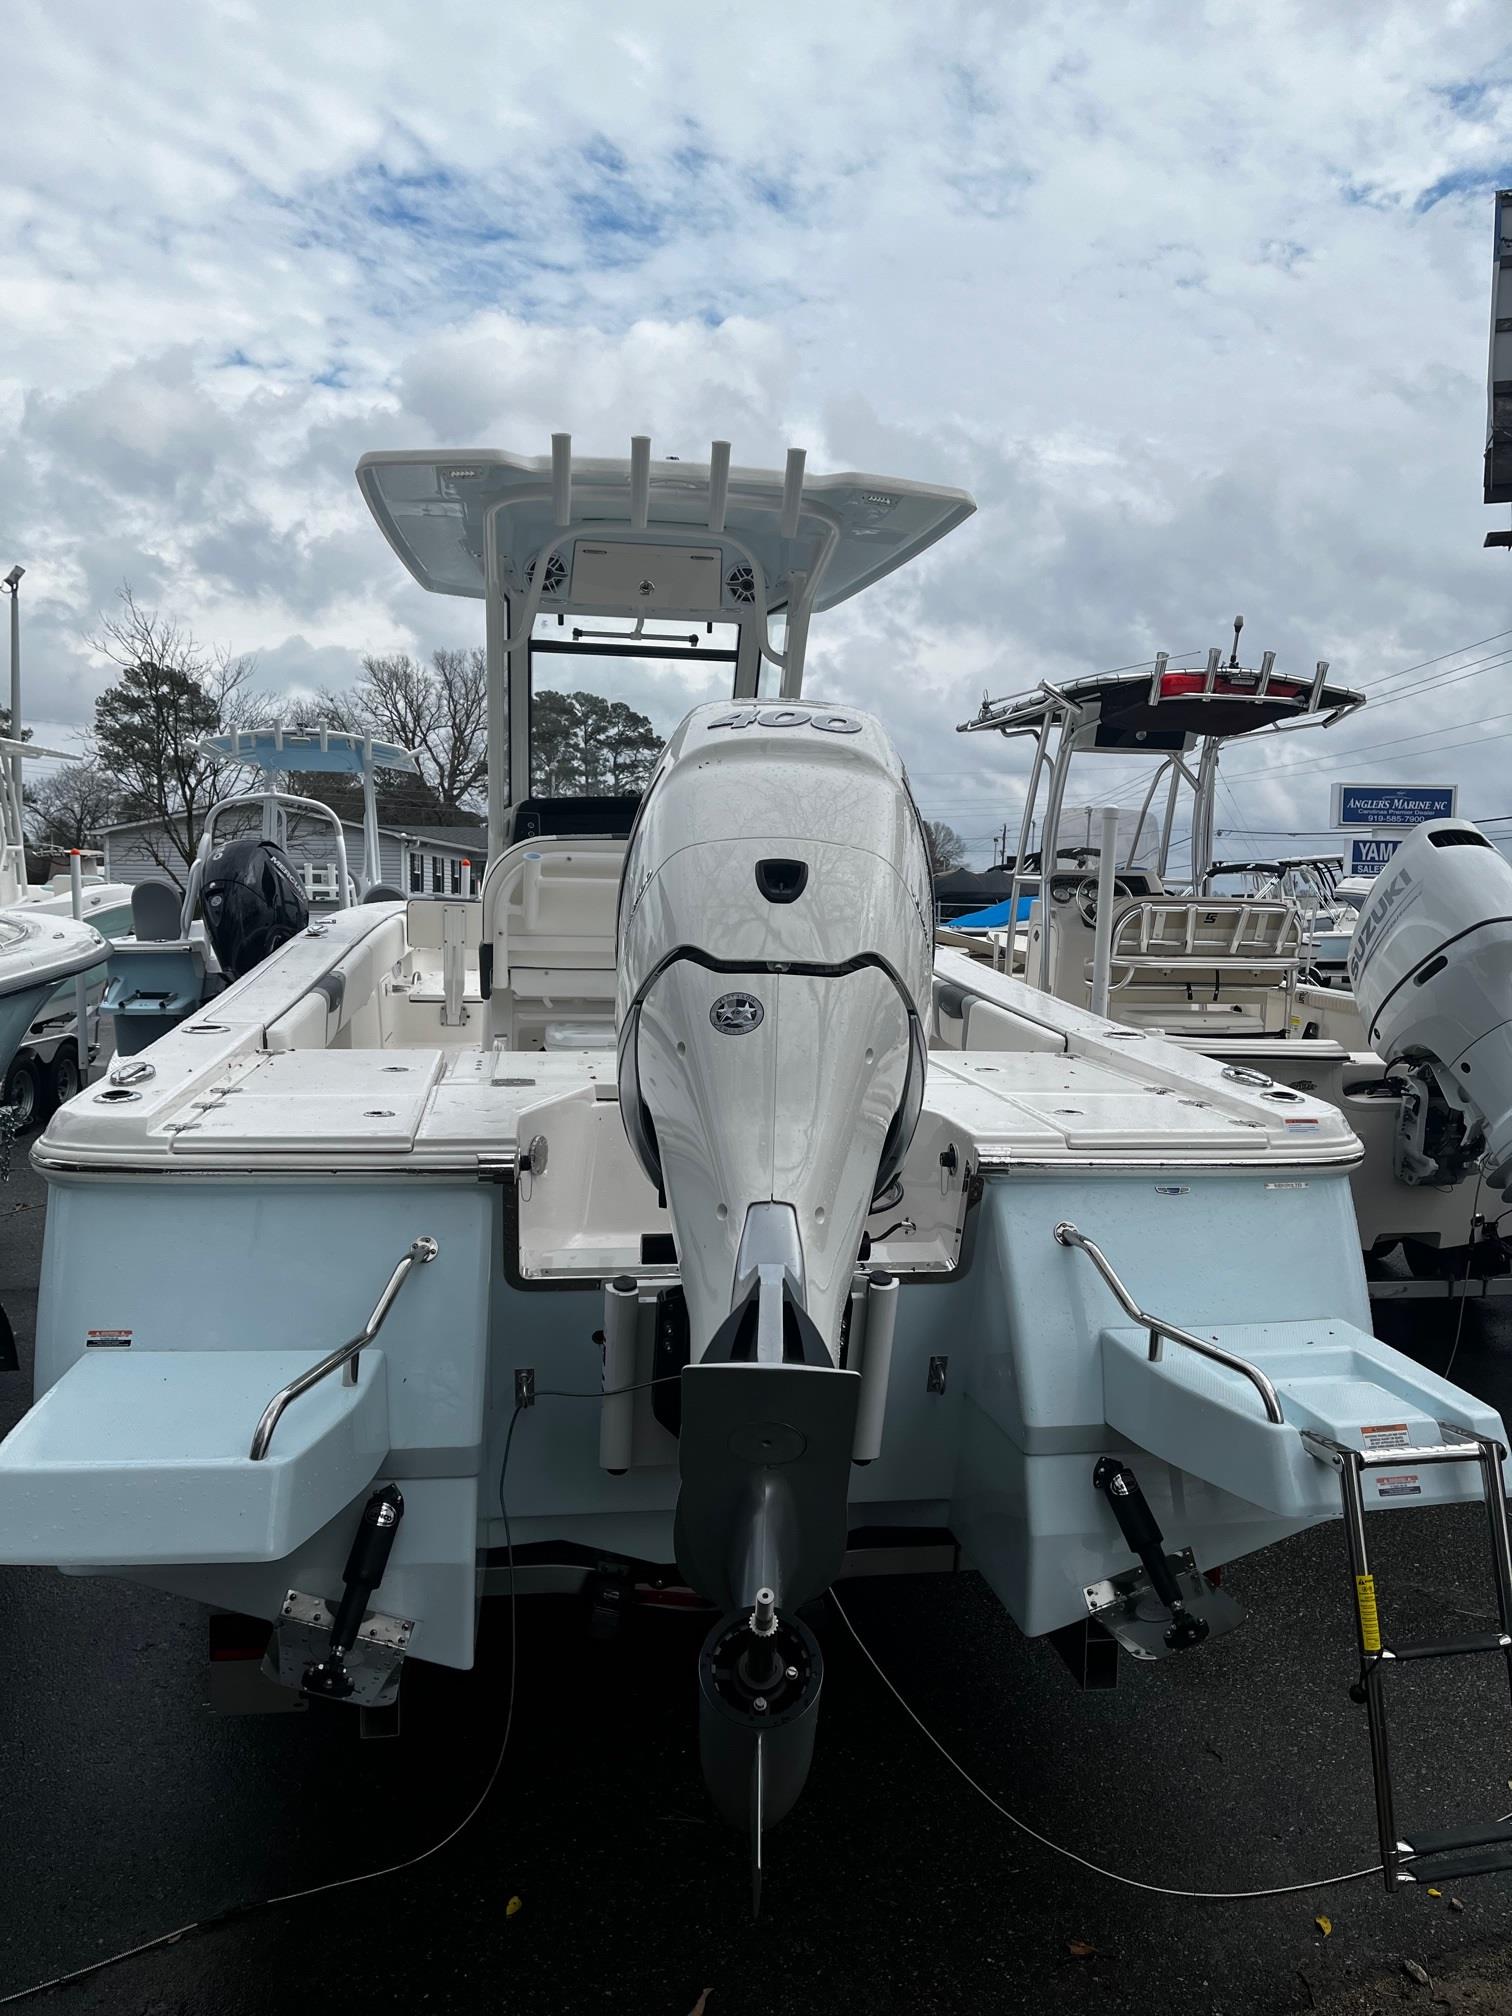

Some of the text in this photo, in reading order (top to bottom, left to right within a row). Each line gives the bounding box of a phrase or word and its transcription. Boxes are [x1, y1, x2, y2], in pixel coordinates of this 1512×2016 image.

[707, 710, 863, 733] 400
[1392, 798, 1432, 810] MARINE
[1433, 801, 1448, 811] NC
[1368, 815, 1425, 823] 919-585-7900
[1359, 842, 1394, 861] YAM
[1351, 868, 1413, 981] SUZUKI
